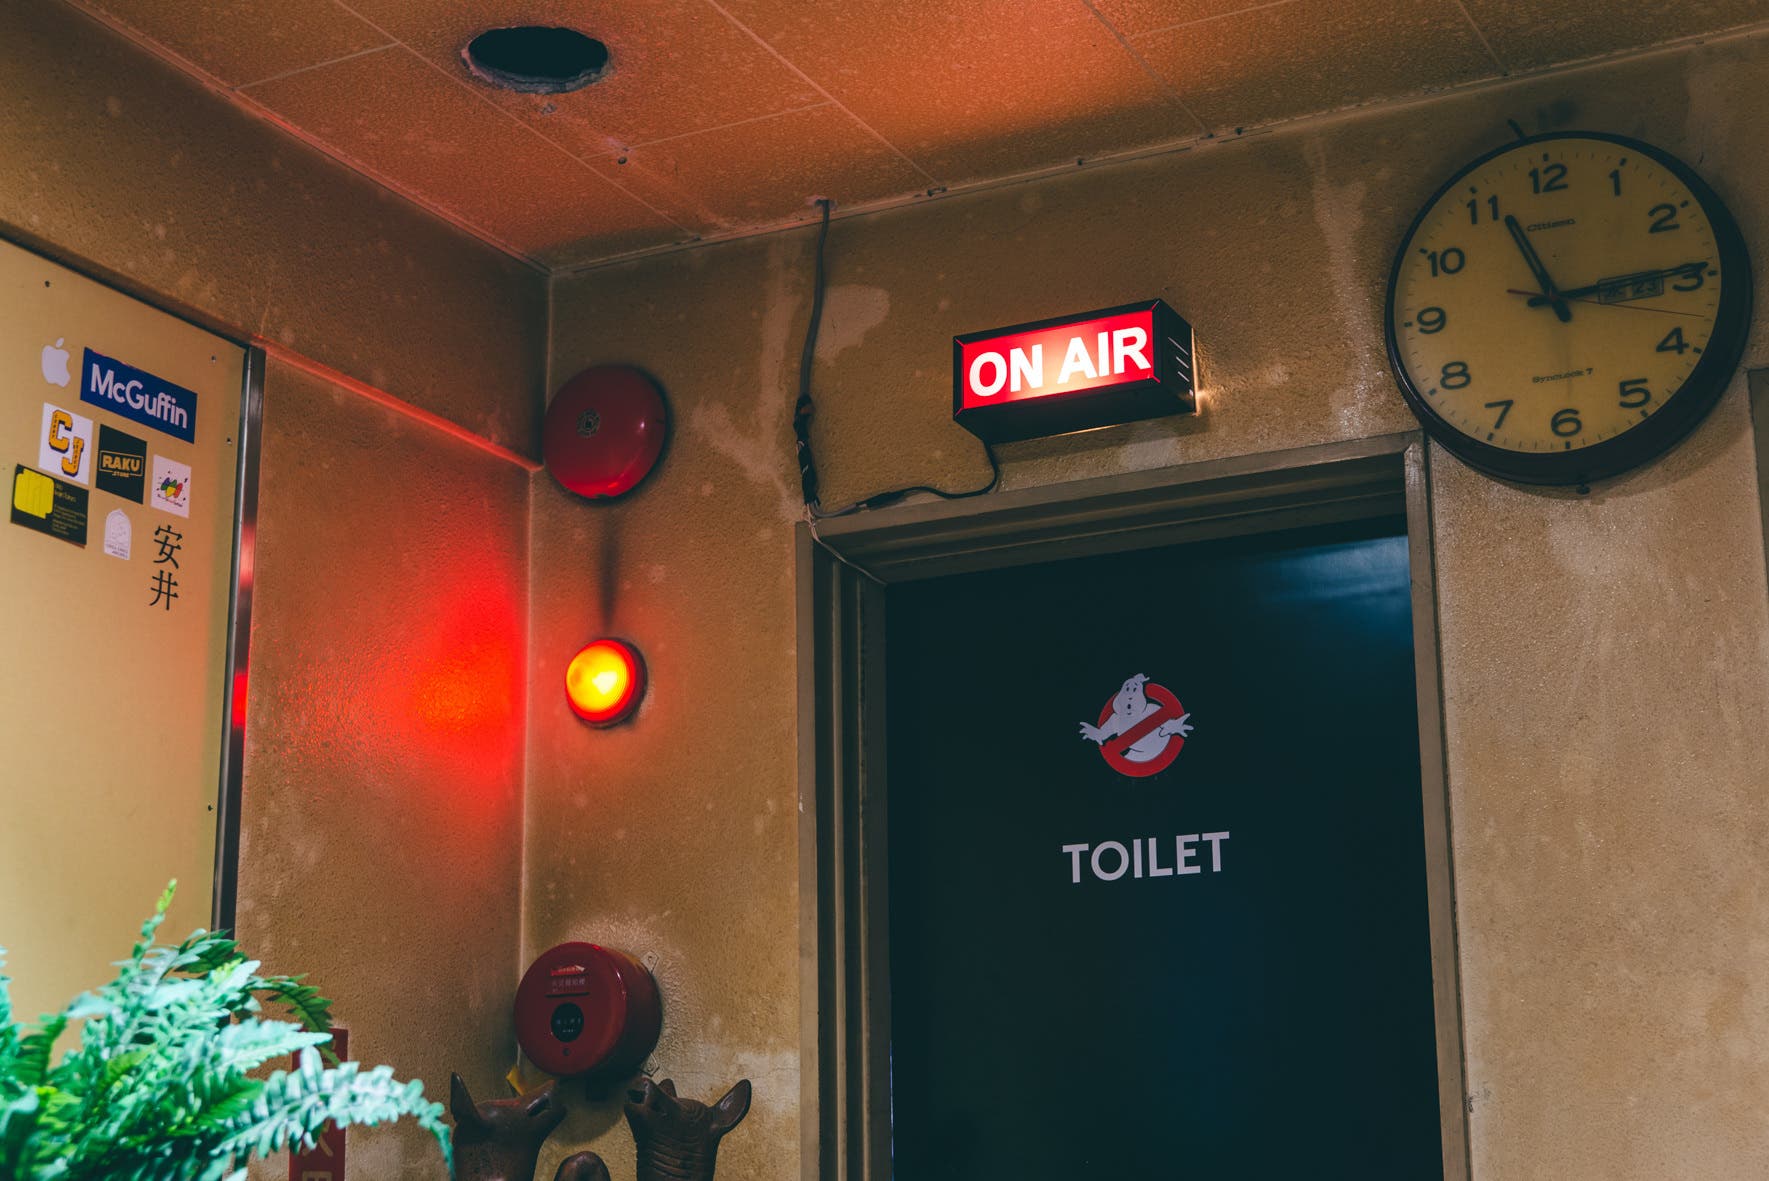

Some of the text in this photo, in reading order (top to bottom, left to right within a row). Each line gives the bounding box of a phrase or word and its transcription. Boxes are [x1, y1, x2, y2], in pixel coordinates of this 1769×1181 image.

[1529, 163, 1568, 193] 12
[1609, 169, 1622, 196] 1
[1466, 195, 1499, 225] 11
[1648, 203, 1681, 234] 2
[1427, 247, 1466, 277] 10
[1672, 261, 1704, 292] 3
[1416, 306, 1447, 334] 9
[1655, 327, 1690, 355] 4
[969, 326, 1151, 397] ON AIR
[1440, 361, 1471, 390] 8
[90, 363, 188, 429] McGuffin
[1619, 378, 1650, 408] 5
[1484, 400, 1514, 429] 7
[1551, 409, 1582, 438] 6
[102, 454, 141, 472] RAKU
[149, 524, 183, 611] 安井
[1062, 831, 1230, 883] TOILET
